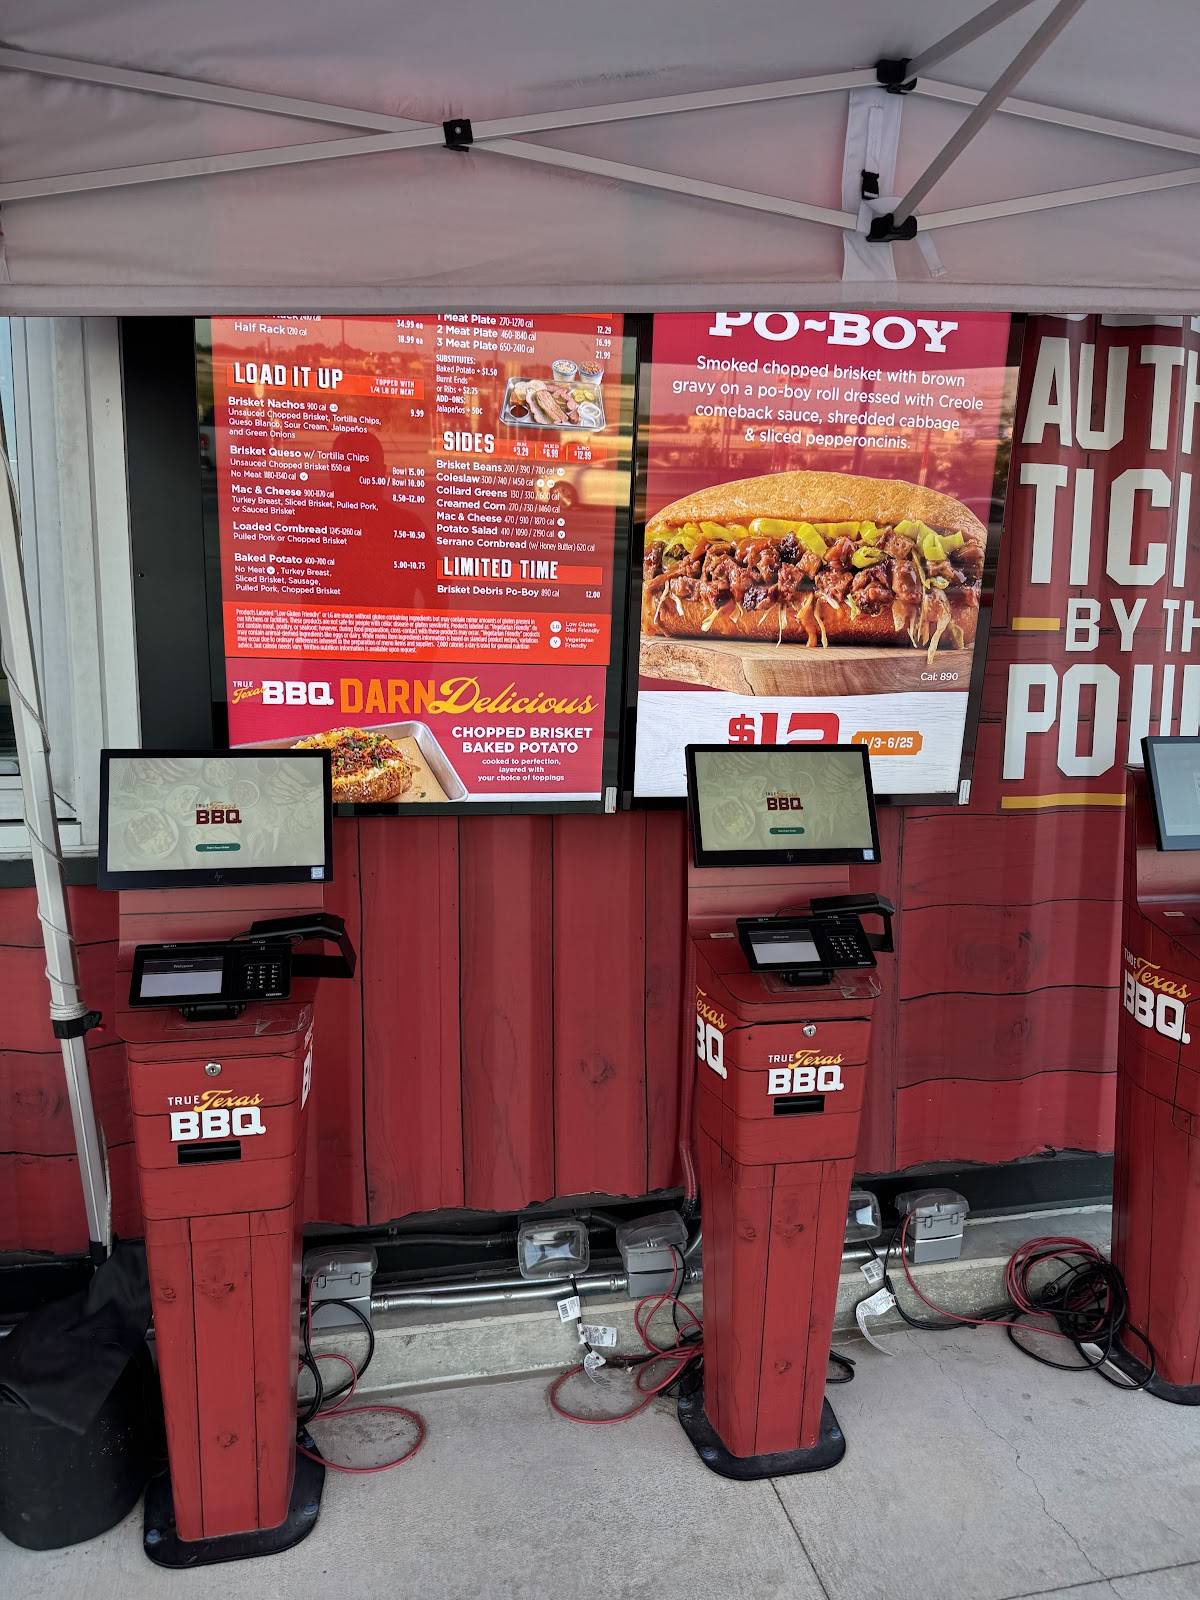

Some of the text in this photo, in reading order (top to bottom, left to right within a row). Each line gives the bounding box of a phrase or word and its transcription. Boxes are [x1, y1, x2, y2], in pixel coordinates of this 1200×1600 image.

[444, 315, 496, 325] Meat Plate
[235, 322, 285, 334] Half Rack
[446, 326, 498, 337] Meat Plate
[597, 326, 611, 334] 12.29
[446, 339, 498, 350] Meat Plate
[436, 365, 457, 373] Baked
[696, 356, 965, 387] Smoked chopped brisket with brown
[234, 362, 343, 389] LOAD IT UP
[673, 378, 984, 410] gravy on a po-boy roll dressed with Creole
[228, 397, 304, 410] Brisket Nachos
[229, 409, 381, 425] Unsauced Chopped Brisket, Tortilla Chips,
[696, 403, 960, 431] comeback sauce, shredded cabbage
[229, 418, 367, 434] Queso Sour Cream, Jalapeños
[246, 429, 268, 437] Green
[270, 431, 295, 439] Onions
[745, 429, 910, 450] & sliced pepperoncinis.
[443, 431, 495, 453] SIDES
[230, 445, 369, 463] Brisket Queso Tortilla Chips
[231, 459, 329, 471] Unsauced Chopped Brisket
[437, 460, 502, 472] Brisket Beans
[231, 470, 241, 478] No
[436, 473, 480, 483] Coleslaw
[232, 485, 252, 494] Mac
[265, 488, 301, 497] Cheese
[436, 486, 507, 498] Collard Greens
[232, 496, 255, 504] Turkey
[285, 498, 306, 506] Sliced
[309, 500, 335, 508] Brisket,
[360, 503, 378, 511] Pork,
[436, 499, 505, 510] Creamed Corn
[271, 507, 295, 515] Brisket
[437, 512, 502, 523] Mac Cheese
[233, 522, 327, 534] Loaded Cornbread
[437, 525, 497, 535] Potato Salad
[234, 533, 256, 541] Pulled
[259, 534, 275, 542] Pork
[288, 535, 320, 544] Chopped
[323, 536, 347, 545] Brisket
[437, 537, 556, 551] Serrano Cornbread Honey
[235, 553, 302, 564] Baked Potato
[248, 566, 266, 574] Meat
[281, 567, 304, 576] Turkey
[306, 569, 332, 577] Breast,
[443, 557, 558, 579] LIMITED TIME
[235, 575, 320, 586] Sliced Brisket, Sausage,
[236, 584, 341, 595] Pulled Pork, Chopped Brisket
[438, 585, 539, 598] Brisket Debris Po-Boy
[586, 590, 600, 598] 12.00
[1065, 598, 1147, 653] BY
[920, 672, 958, 681] Cal: 890
[232, 686, 265, 705] Texas
[340, 676, 598, 714] DARN Delicious
[452, 726, 593, 739] CHOPPED BRISKET
[463, 742, 578, 754] BAKED POTATO
[521, 758, 561, 766] perfection,
[1124, 947, 1192, 999] TRUE Texas
[769, 1049, 845, 1069] TRUE Texas
[168, 1089, 264, 1113] TRUE Texas
